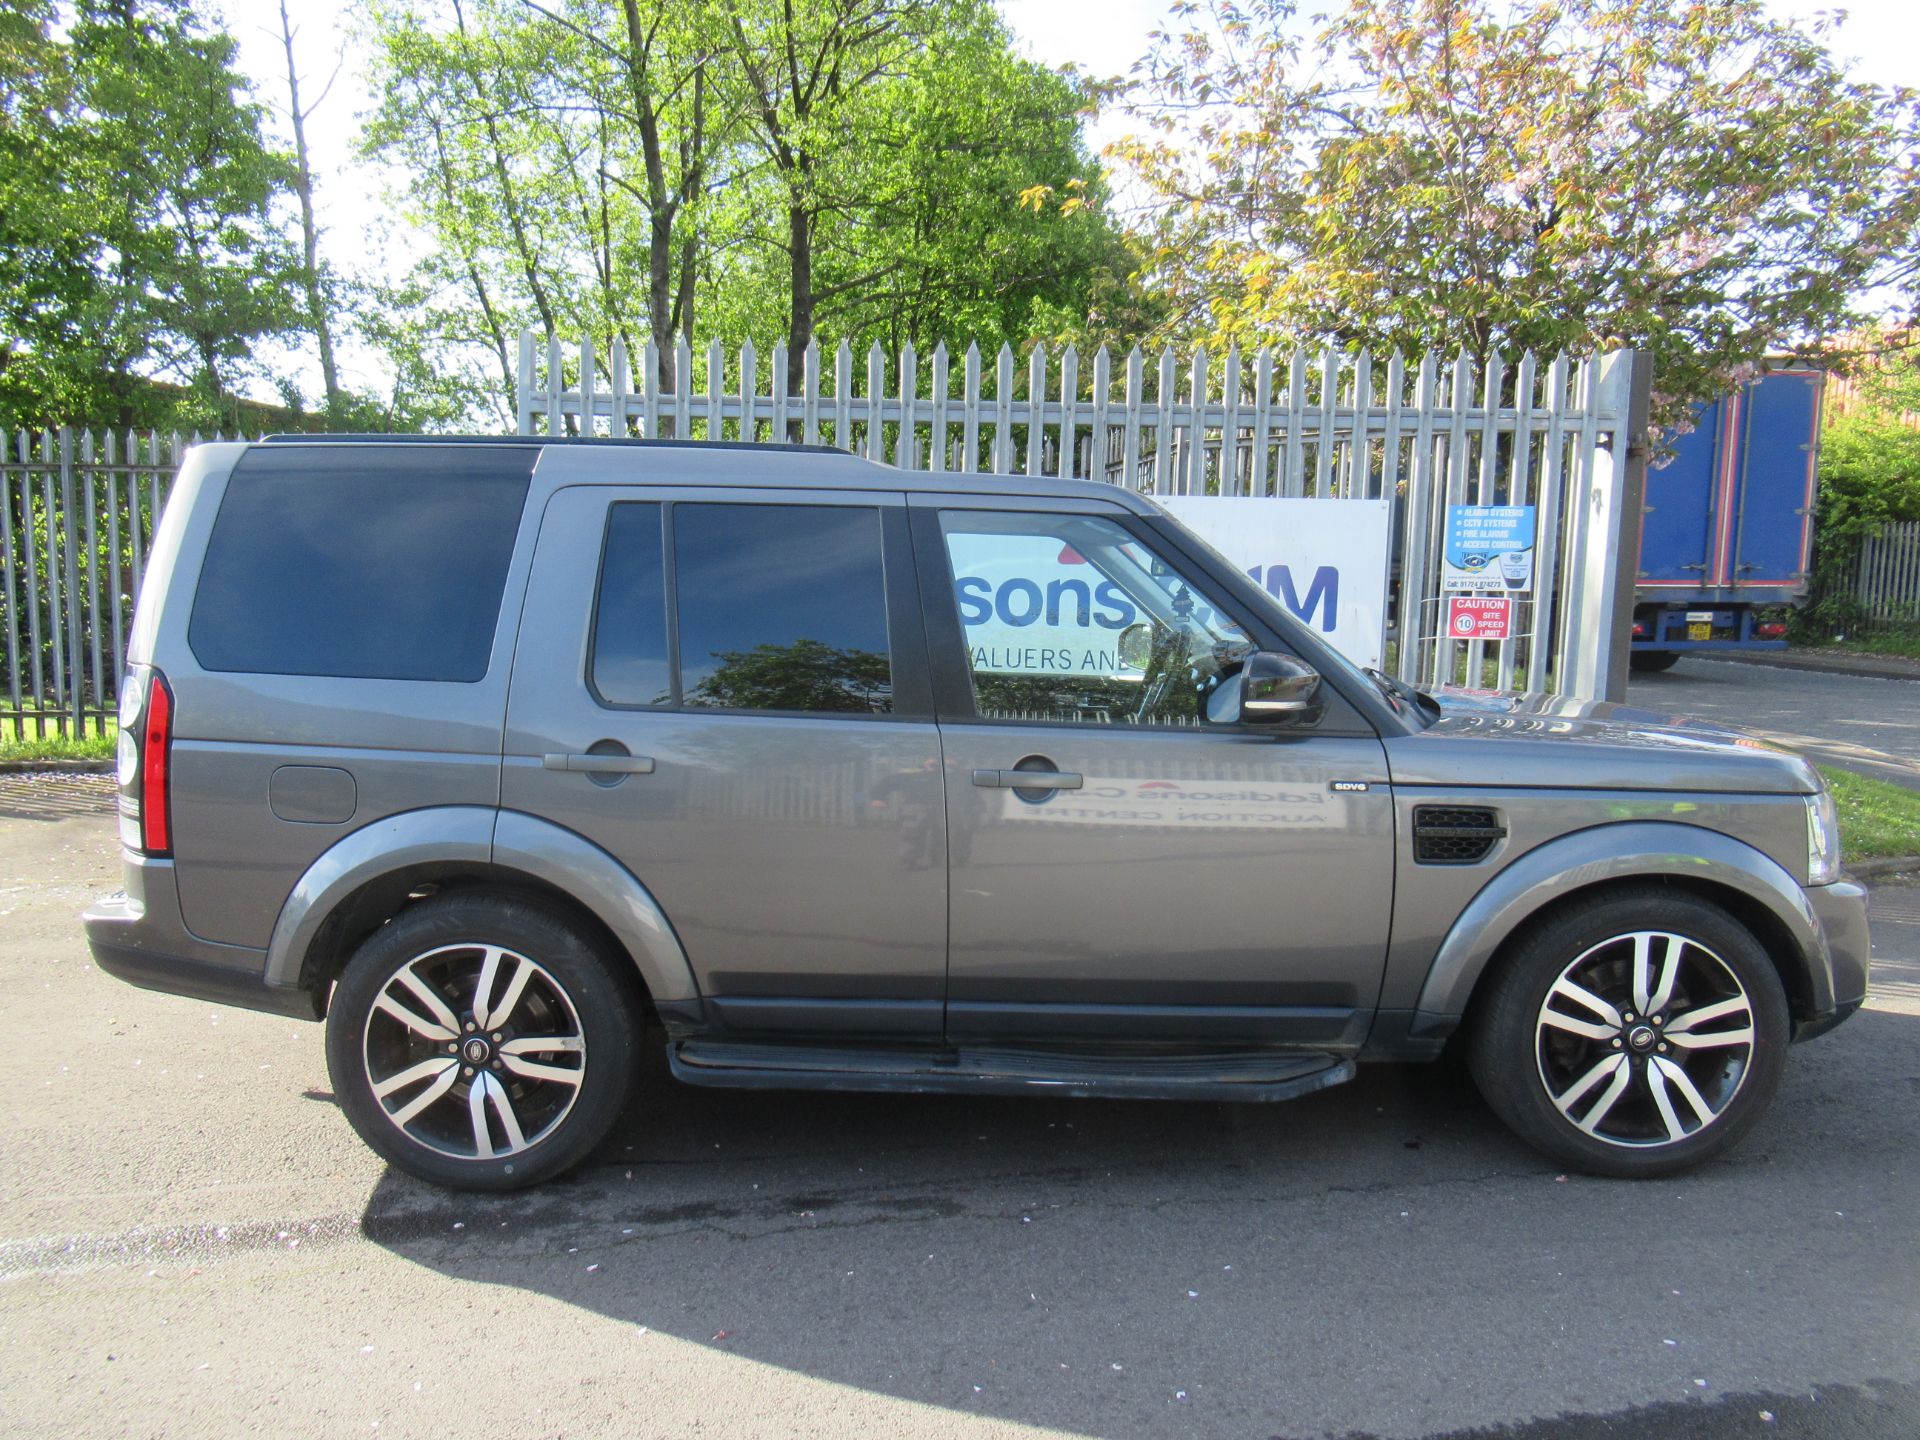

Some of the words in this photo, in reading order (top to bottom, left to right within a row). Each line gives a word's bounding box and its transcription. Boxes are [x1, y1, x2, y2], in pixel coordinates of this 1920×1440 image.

[1463, 519, 1482, 527] CCTV
[1483, 519, 1517, 527] SYSTEMS
[1457, 600, 1504, 609] CAUTION
[1459, 618, 1471, 629] 10
[1335, 783, 1366, 791] SDV6
